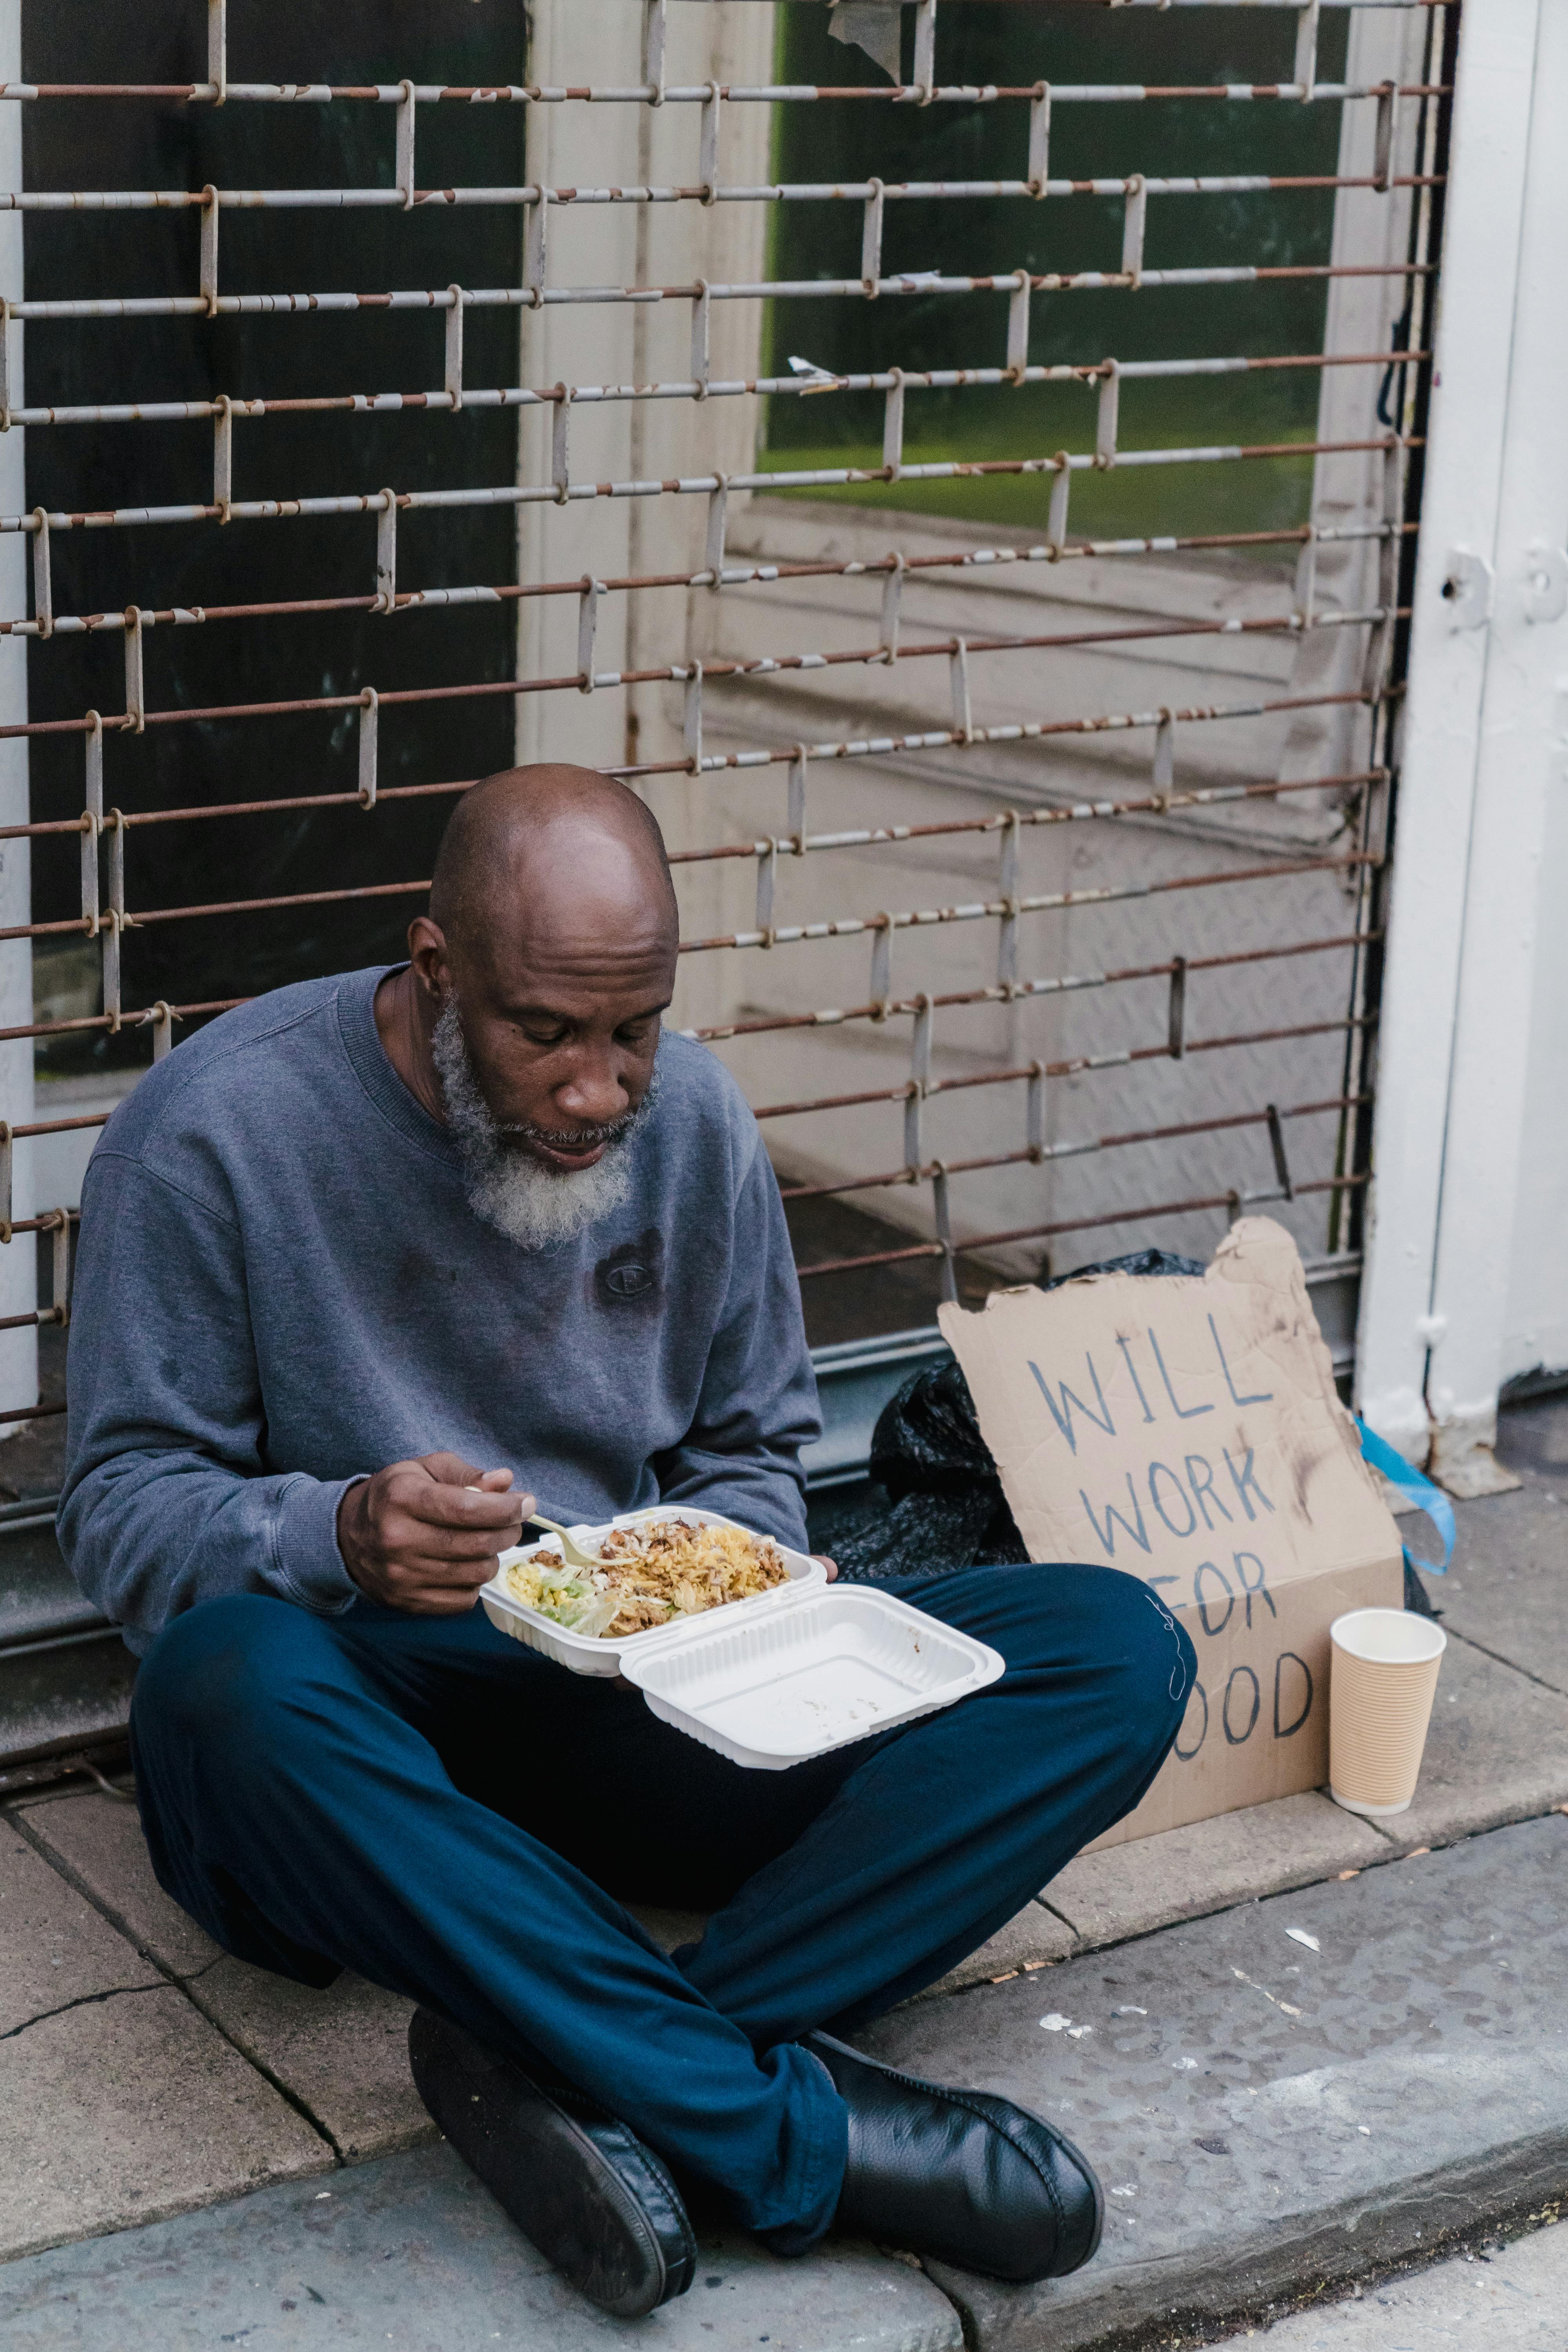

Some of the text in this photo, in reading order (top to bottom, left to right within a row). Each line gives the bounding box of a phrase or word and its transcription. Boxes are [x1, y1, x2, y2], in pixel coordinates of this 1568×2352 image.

[1027, 1313, 1274, 1456] WILL
[1079, 1446, 1276, 1557] WORK
[1174, 1652, 1313, 1761] OOD
